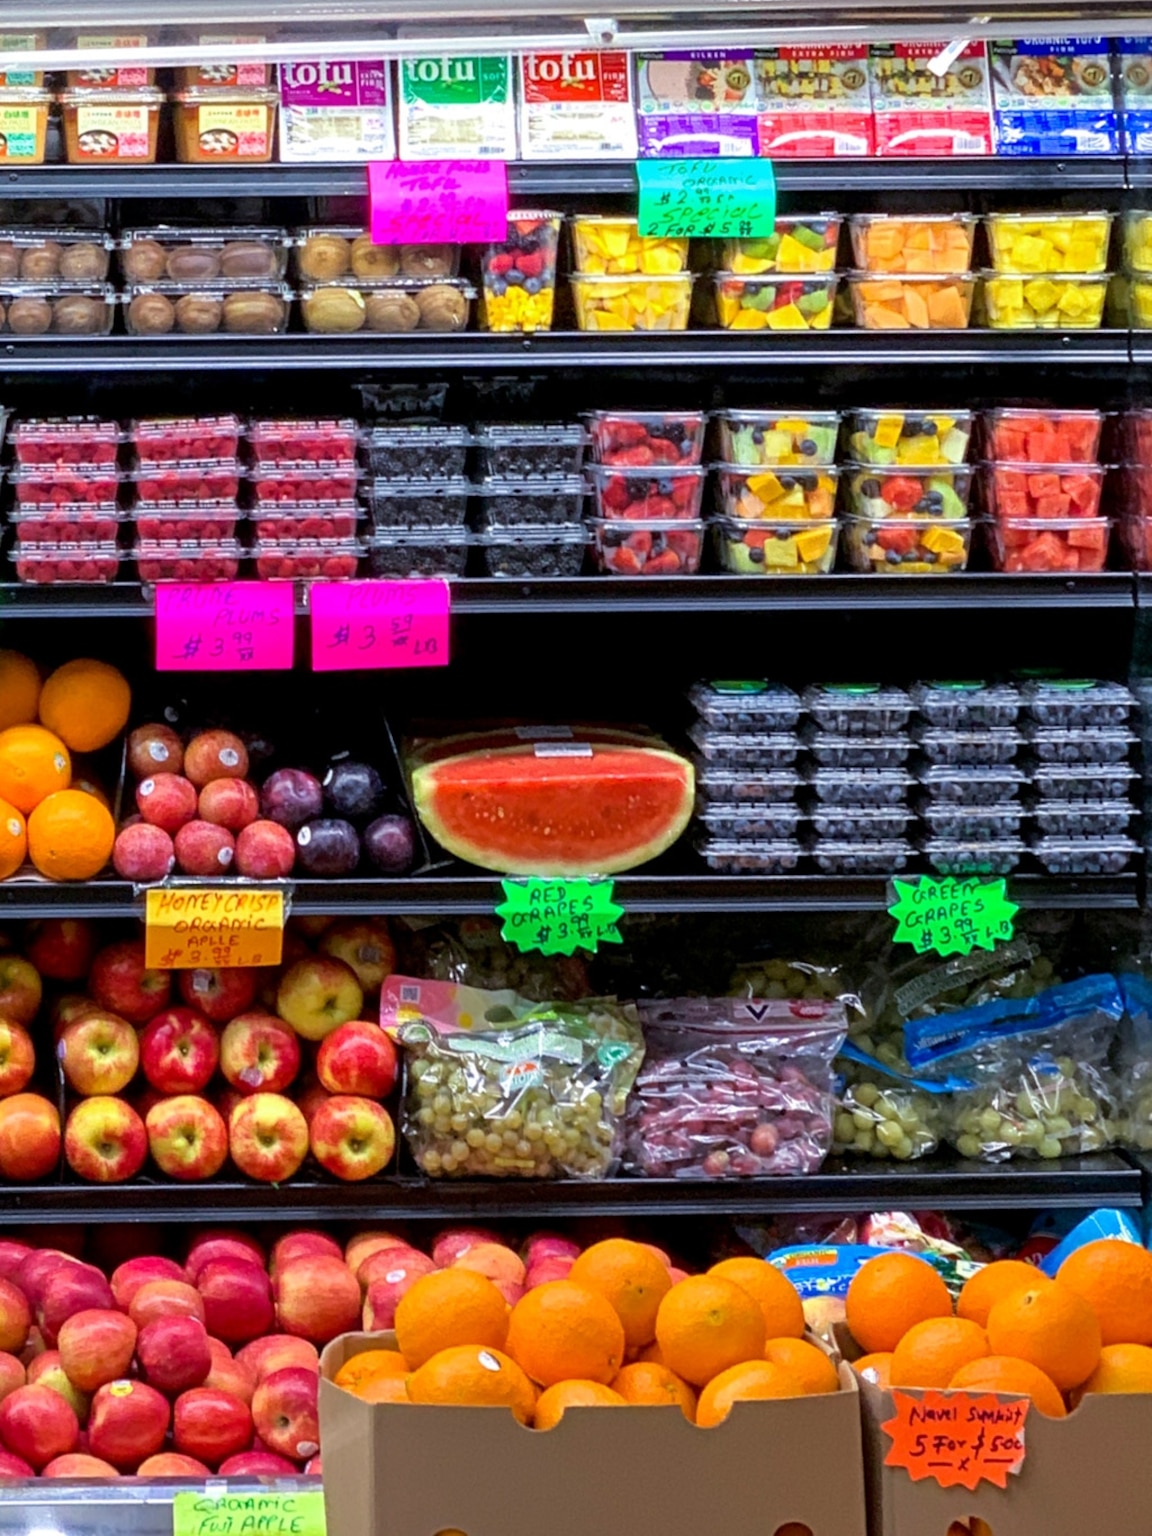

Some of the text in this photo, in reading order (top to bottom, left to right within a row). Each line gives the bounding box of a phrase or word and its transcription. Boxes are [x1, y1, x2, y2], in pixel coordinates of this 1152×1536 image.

[283, 61, 354, 88] tofu
[405, 56, 476, 82] tofu
[528, 52, 596, 82] tofu
[529, 886, 566, 905] RED
[912, 883, 979, 905] GREEN
[511, 895, 594, 928] GRAPES
[905, 898, 985, 928] GRAPES
[909, 1434, 928, 1456] 5
